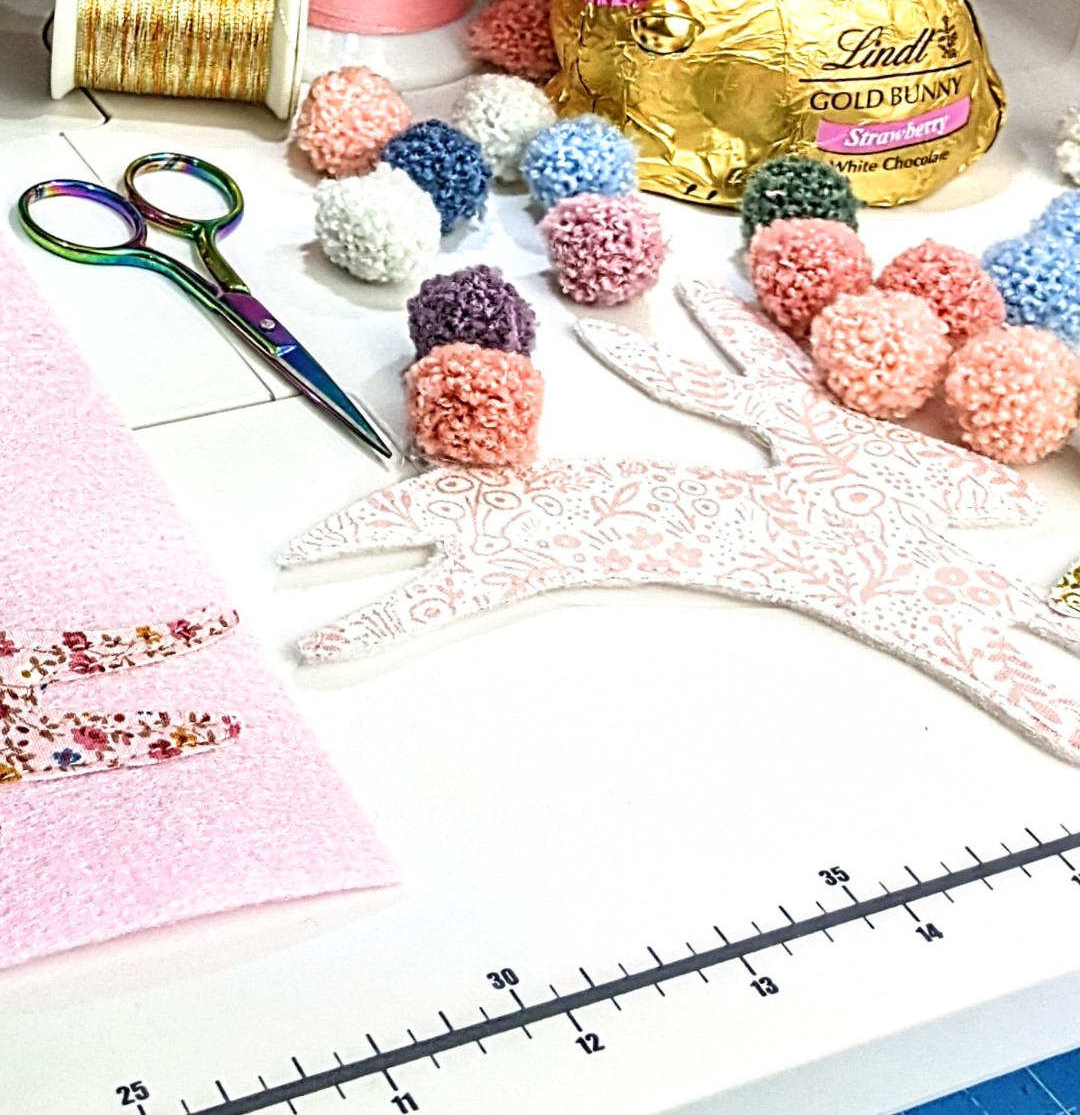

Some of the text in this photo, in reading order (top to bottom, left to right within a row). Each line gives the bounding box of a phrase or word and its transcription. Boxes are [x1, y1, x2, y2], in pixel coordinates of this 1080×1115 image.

[822, 26, 936, 70] Lindt
[810, 75, 962, 110] GOLD BUNNY
[844, 115, 950, 147] Strawberry
[830, 149, 949, 173] White Chocolate
[818, 866, 850, 886] 35
[915, 923, 944, 942] 14
[486, 968, 520, 990] 30
[750, 976, 779, 997] 13
[575, 1033, 606, 1055] 12
[115, 1080, 150, 1106] 25
[391, 1092, 419, 1114] 11
